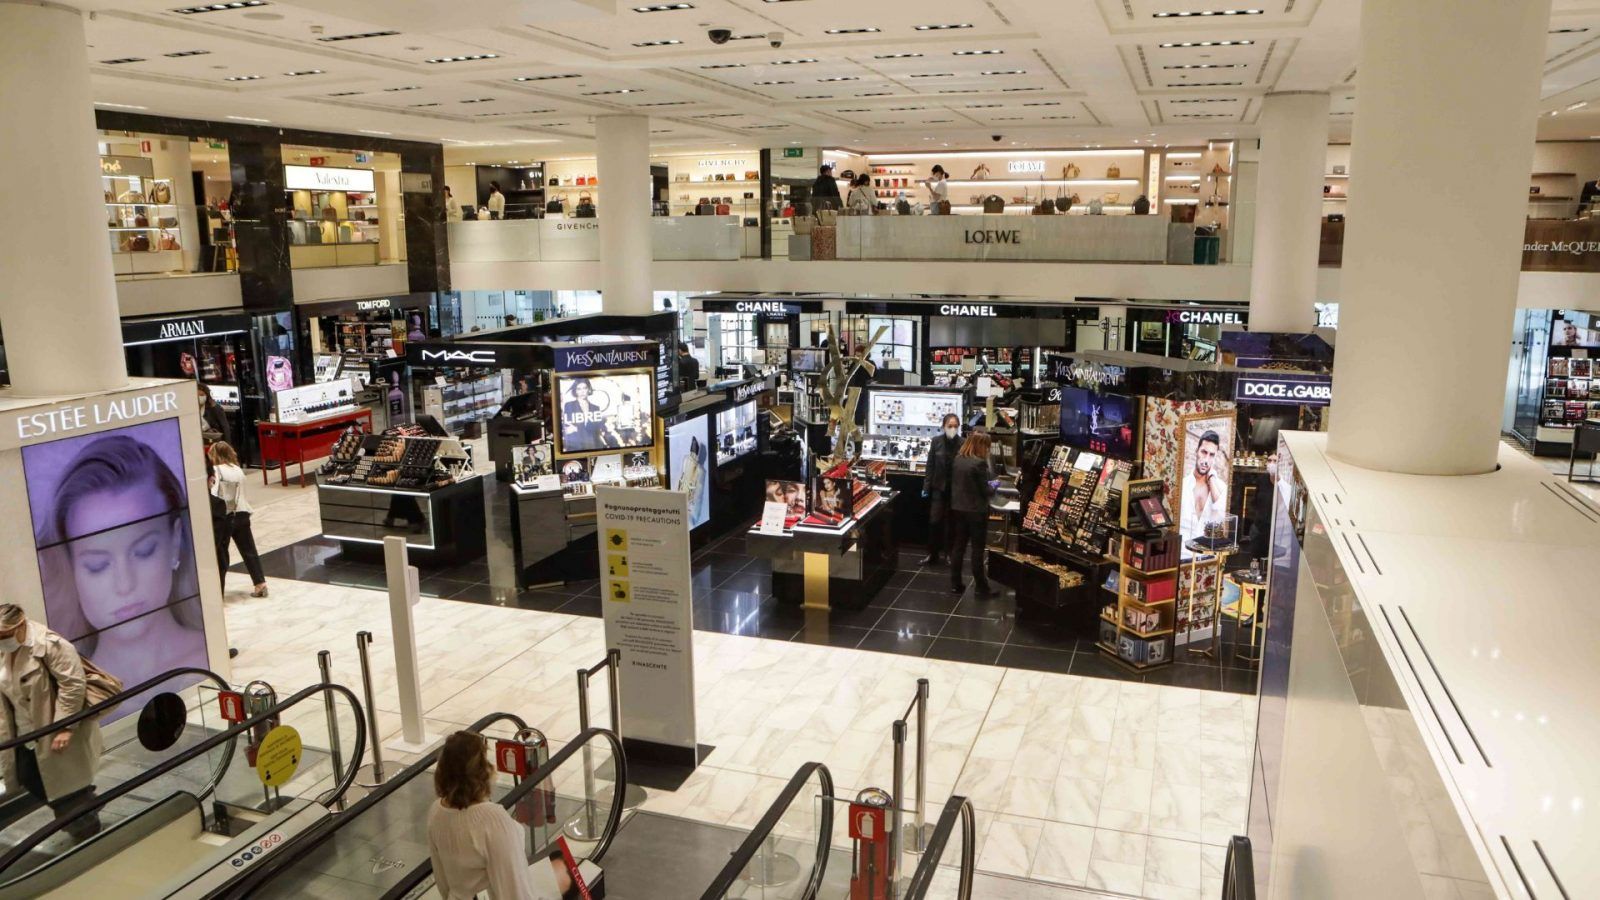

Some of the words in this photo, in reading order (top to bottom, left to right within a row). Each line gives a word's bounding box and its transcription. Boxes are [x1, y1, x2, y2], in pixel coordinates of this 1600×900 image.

[556, 222, 599, 231] GIVENCH
[965, 230, 1021, 244] LOEWE
[1523, 241, 1549, 251] nder
[356, 301, 372, 310] TOM
[372, 299, 391, 308] FORD
[736, 301, 788, 312] CHANEL
[940, 304, 997, 317] CHANEL
[1180, 311, 1243, 324] CHANEL
[160, 320, 205, 338] ARMANI
[1244, 383, 1287, 397] DOLCE
[1293, 385, 1331, 399] GABB
[94, 391, 178, 425] LAUDER
[564, 411, 602, 423] LIBRE
[605, 513, 634, 521] COVID-19
[635, 515, 681, 525] PRECAUTIONS
[632, 660, 668, 670] RINASCENTE
